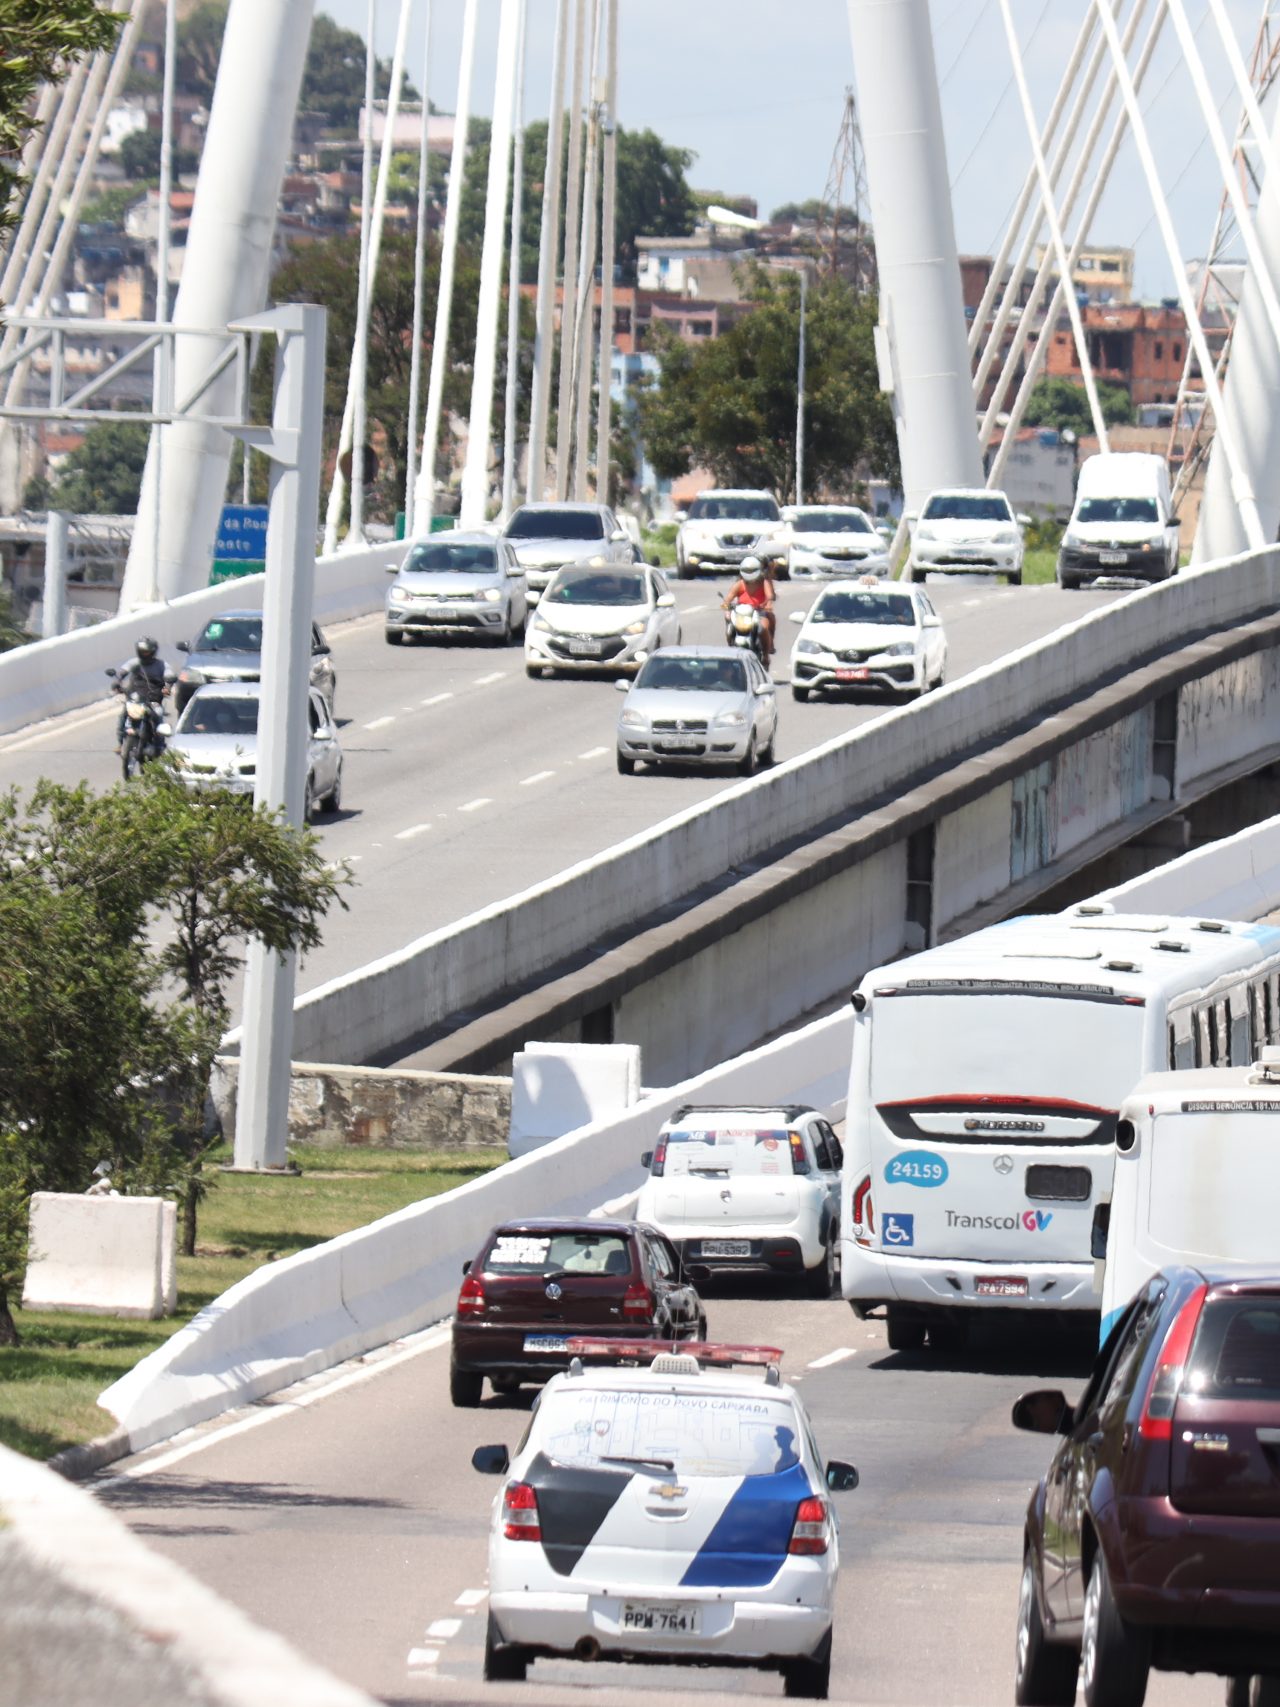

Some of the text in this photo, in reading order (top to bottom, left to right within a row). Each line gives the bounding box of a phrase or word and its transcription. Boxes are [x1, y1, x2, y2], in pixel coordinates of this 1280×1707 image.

[1187, 1102, 1215, 1111] DISQUE
[892, 1161, 943, 1179] 24159
[653, 1398, 670, 1407] DO
[673, 1399, 707, 1409] POVO
